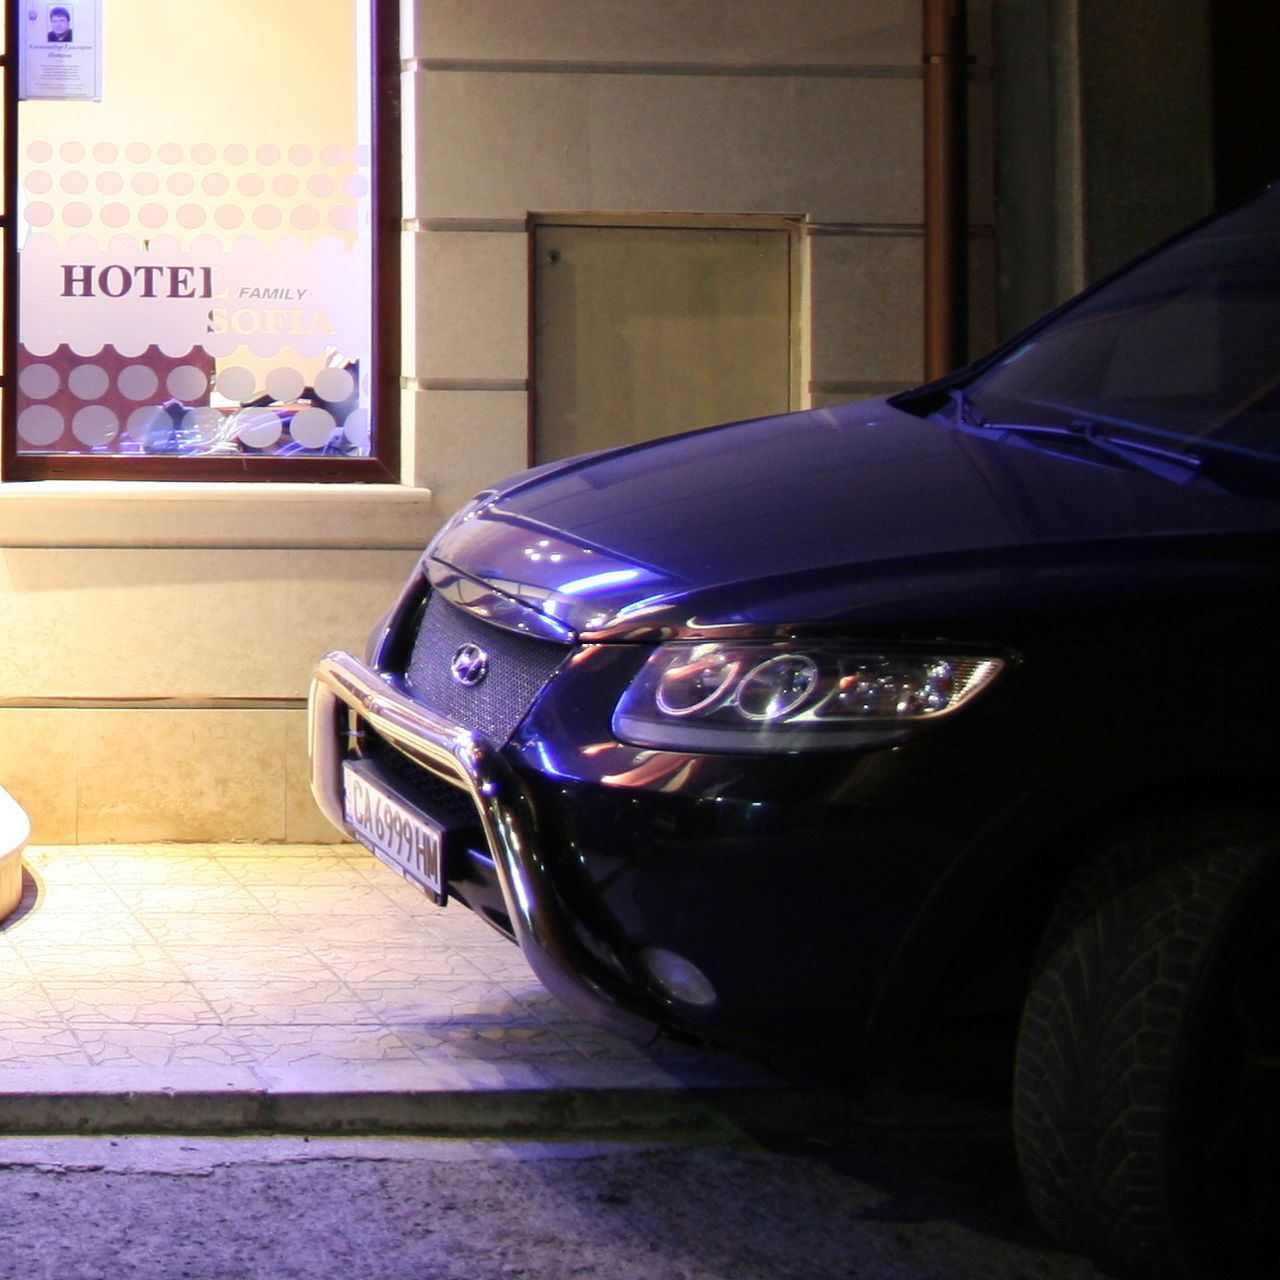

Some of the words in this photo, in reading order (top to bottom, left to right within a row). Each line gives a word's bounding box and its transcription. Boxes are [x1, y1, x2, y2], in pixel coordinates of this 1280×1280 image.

[60, 264, 230, 299] HOTEL
[238, 287, 308, 301] FAMILY
[206, 307, 336, 335] SOFIA
